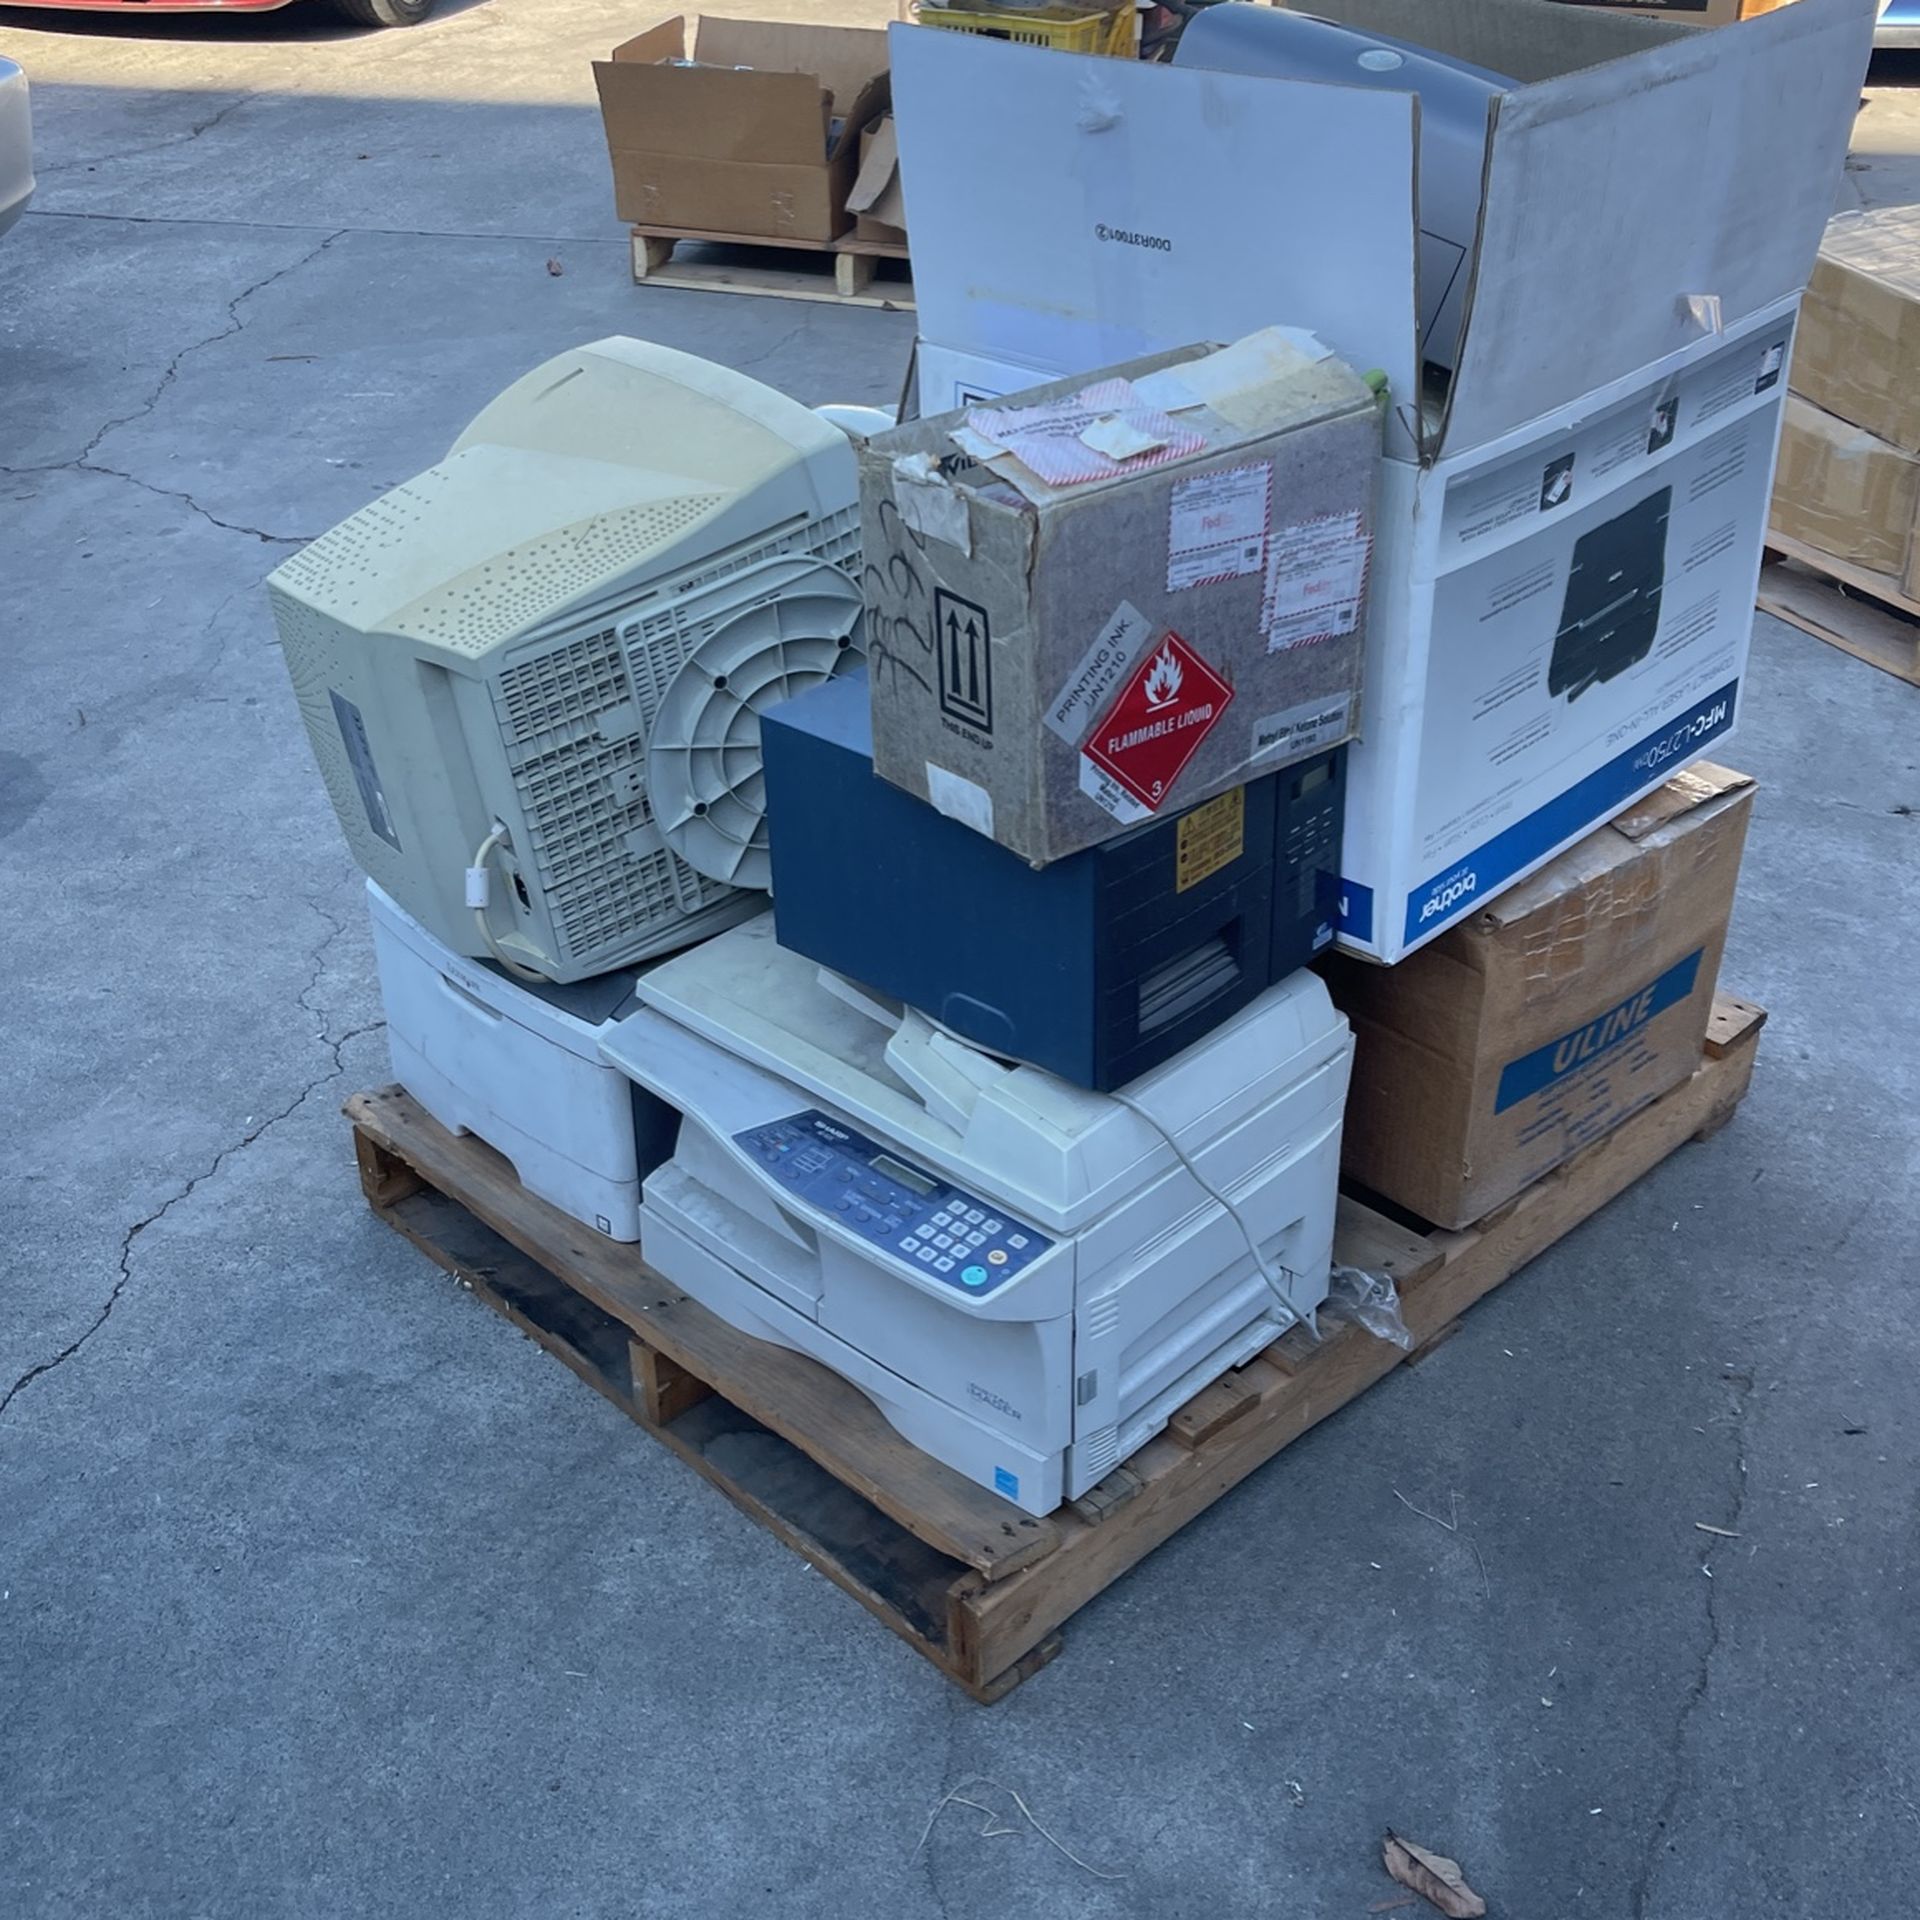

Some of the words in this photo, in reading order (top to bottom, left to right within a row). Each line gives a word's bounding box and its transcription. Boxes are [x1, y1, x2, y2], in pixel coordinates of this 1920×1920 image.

[1056, 649, 1110, 723] PRINTING
[1108, 620, 1131, 648] INK
[1084, 651, 1127, 707] UN1210
[941, 717, 960, 735] THIS
[962, 728, 979, 745] END
[982, 737, 993, 750] UP
[1108, 716, 1176, 755] FLAMMABLE
[1177, 703, 1213, 730] LIQUID
[1151, 780, 1162, 797] 3
[1418, 872, 1477, 924] brother
[1552, 983, 1657, 1074] ULINE
